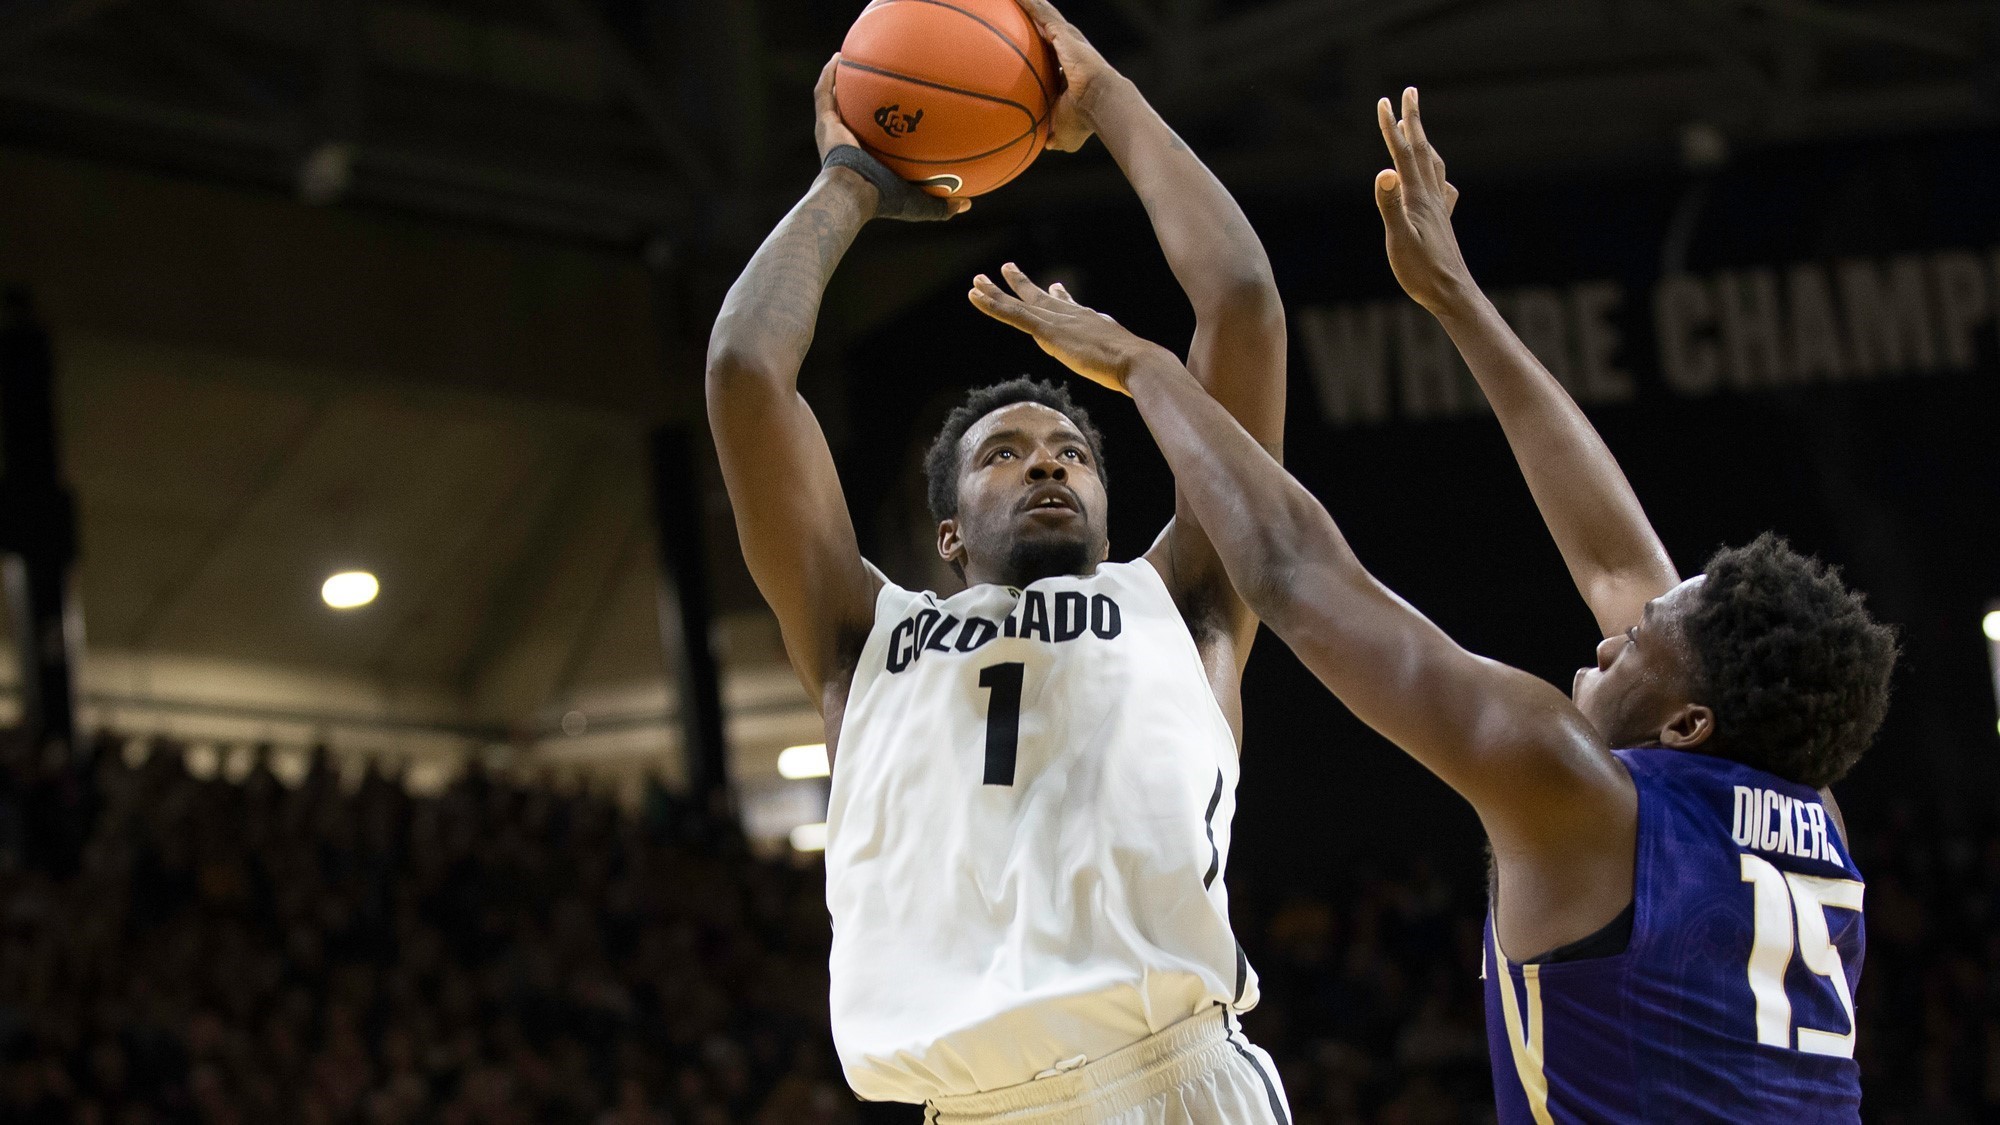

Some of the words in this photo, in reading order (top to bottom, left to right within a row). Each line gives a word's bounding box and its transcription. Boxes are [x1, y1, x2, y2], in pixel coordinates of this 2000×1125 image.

[1299, 278, 1637, 426] WHRE
[978, 661, 1025, 787] 1
[1740, 853, 1866, 1059] 15
